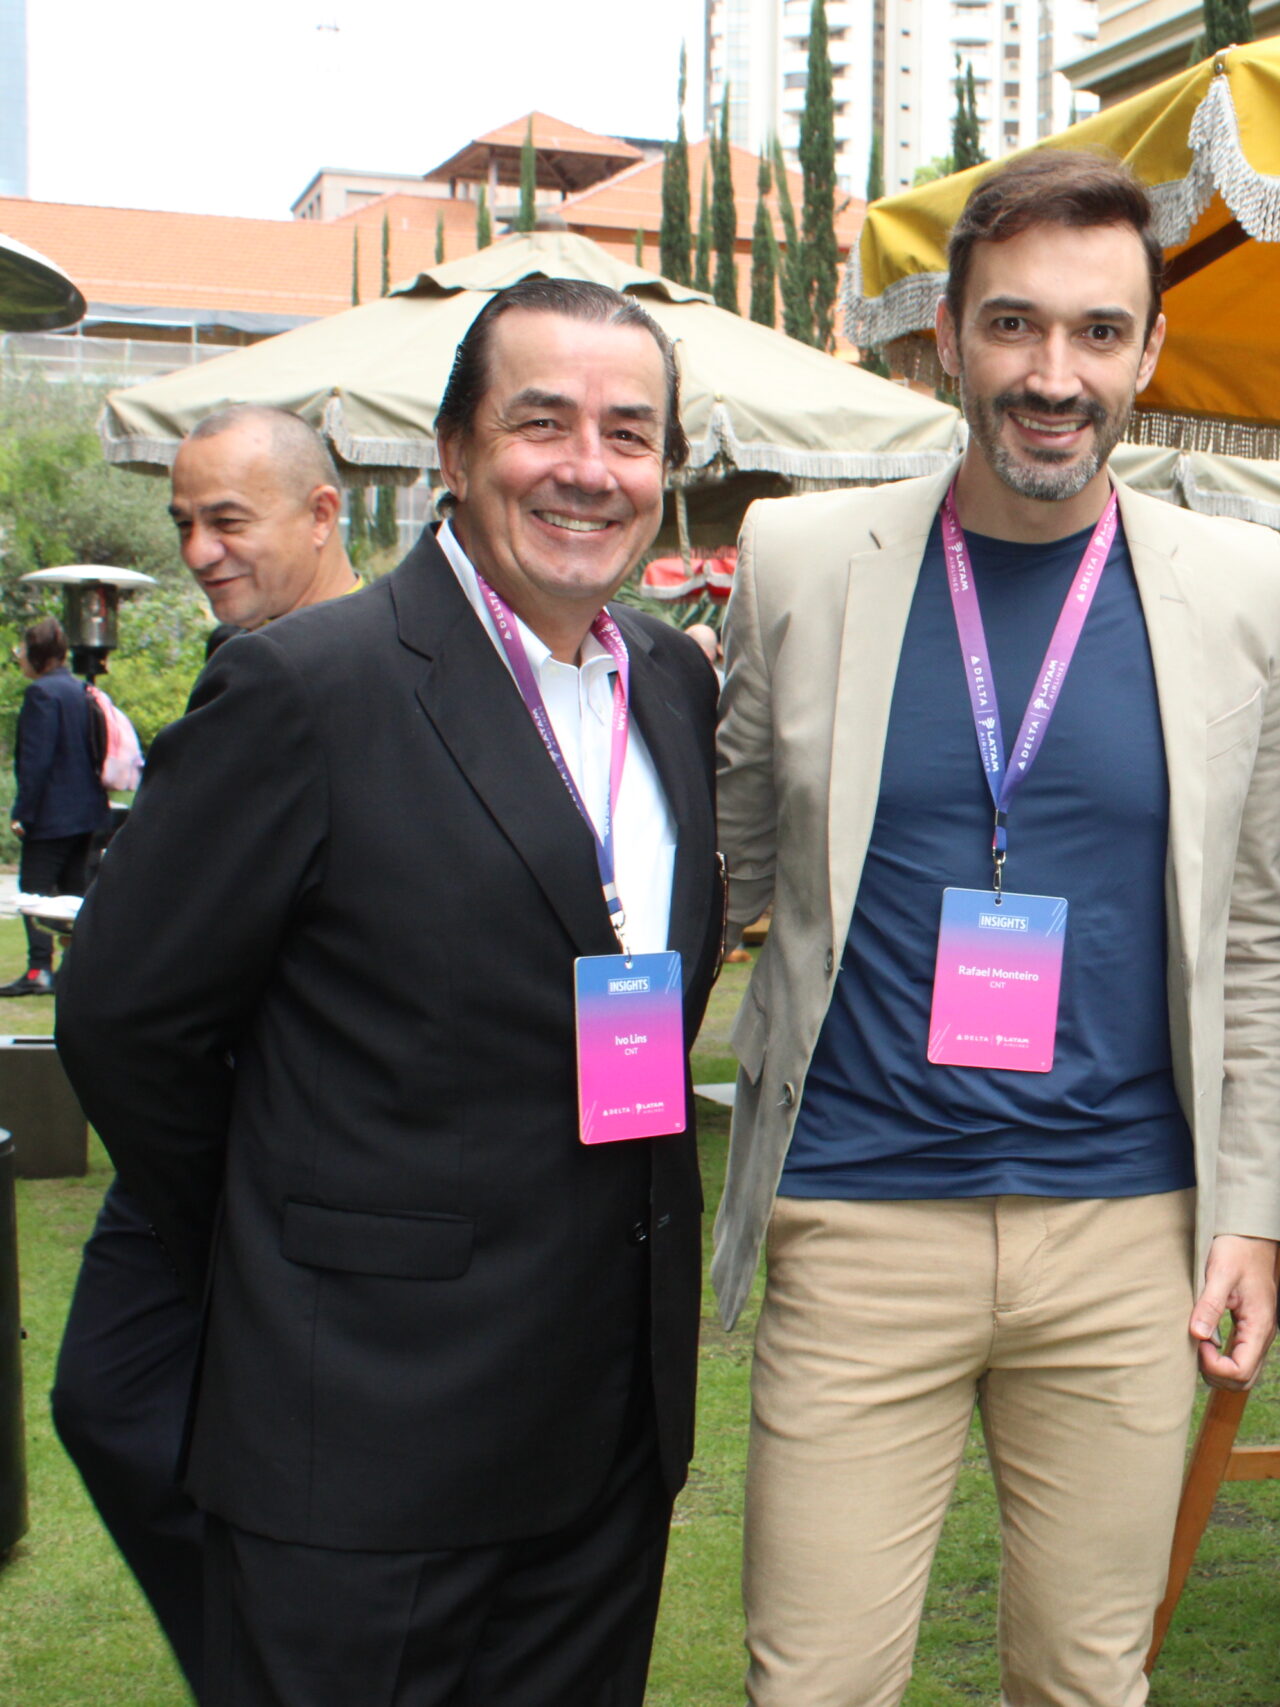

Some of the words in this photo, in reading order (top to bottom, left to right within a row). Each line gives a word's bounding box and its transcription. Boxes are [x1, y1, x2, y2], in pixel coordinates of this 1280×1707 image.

[949, 556, 959, 593] AIRLINES
[956, 553, 969, 591] LATAM
[1078, 557, 1099, 592] DELTA
[488, 590, 508, 629] DELTA
[1049, 661, 1066, 700] AIRLINES
[973, 667, 989, 706] DELTA
[987, 731, 999, 773] LATAM
[1020, 720, 1041, 759] DELTA
[1038, 659, 1059, 698] LATAM
[532, 707, 552, 750] LATAM
[979, 732, 991, 773] AIRLINES
[980, 915, 1027, 930] INSIGHTS
[609, 979, 649, 993] INSIGHTS
[958, 965, 991, 977] Rafael
[992, 968, 1039, 981] Monteiro
[989, 981, 1007, 989] CNT
[615, 1035, 629, 1046] Ivo
[630, 1033, 647, 1045] Lins
[624, 1047, 640, 1056] CNT
[964, 1034, 989, 1042] DELTA
[609, 1107, 631, 1115] DELTA
[642, 1101, 665, 1109] LATAM
